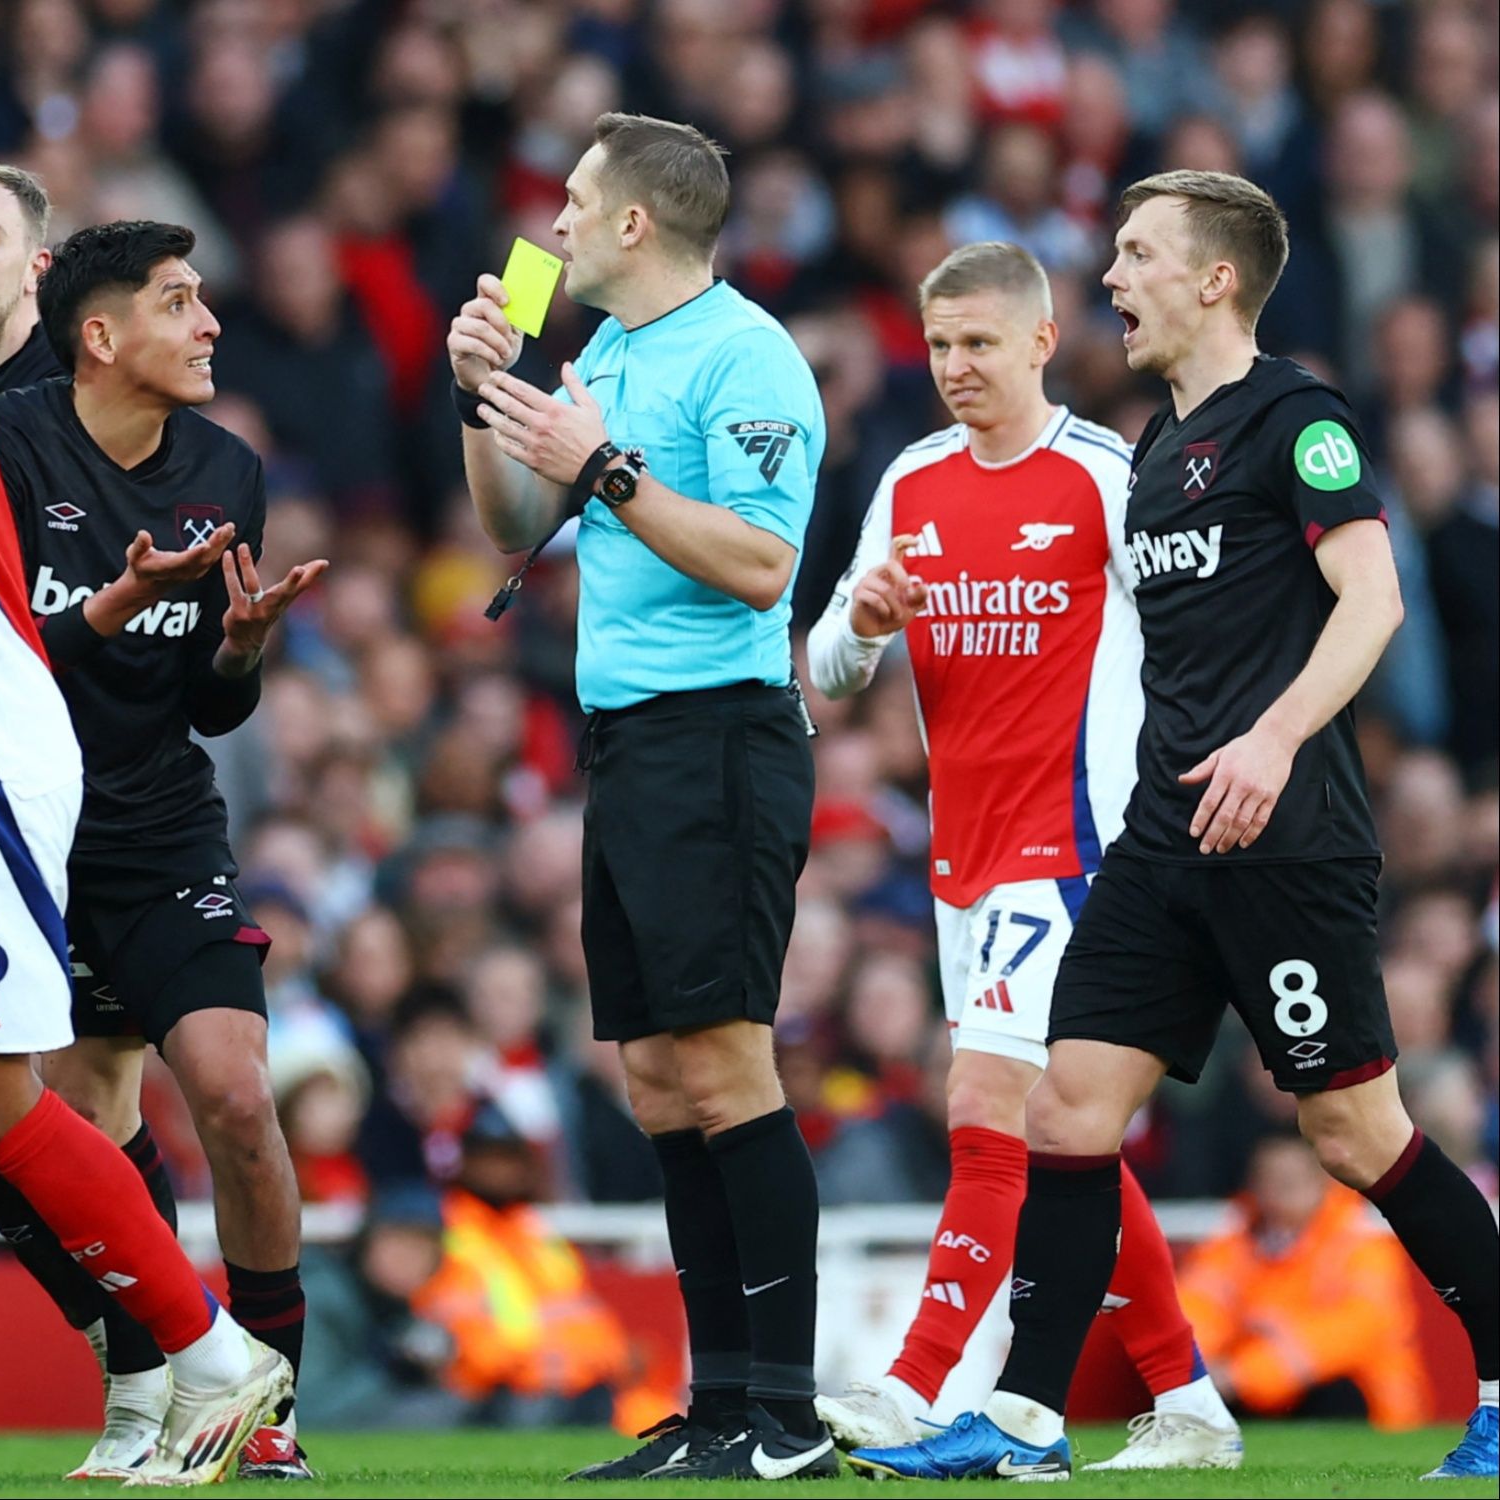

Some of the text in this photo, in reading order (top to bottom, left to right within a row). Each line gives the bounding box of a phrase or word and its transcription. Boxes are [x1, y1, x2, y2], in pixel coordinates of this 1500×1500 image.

[754, 421, 790, 434] SPORTS
[47, 520, 80, 532] umbro
[930, 622, 1040, 656] FLY BETTER
[980, 909, 1052, 977] 17
[1269, 959, 1328, 1037] 8
[1294, 1057, 1326, 1070] umbro
[937, 1230, 992, 1263] AFC
